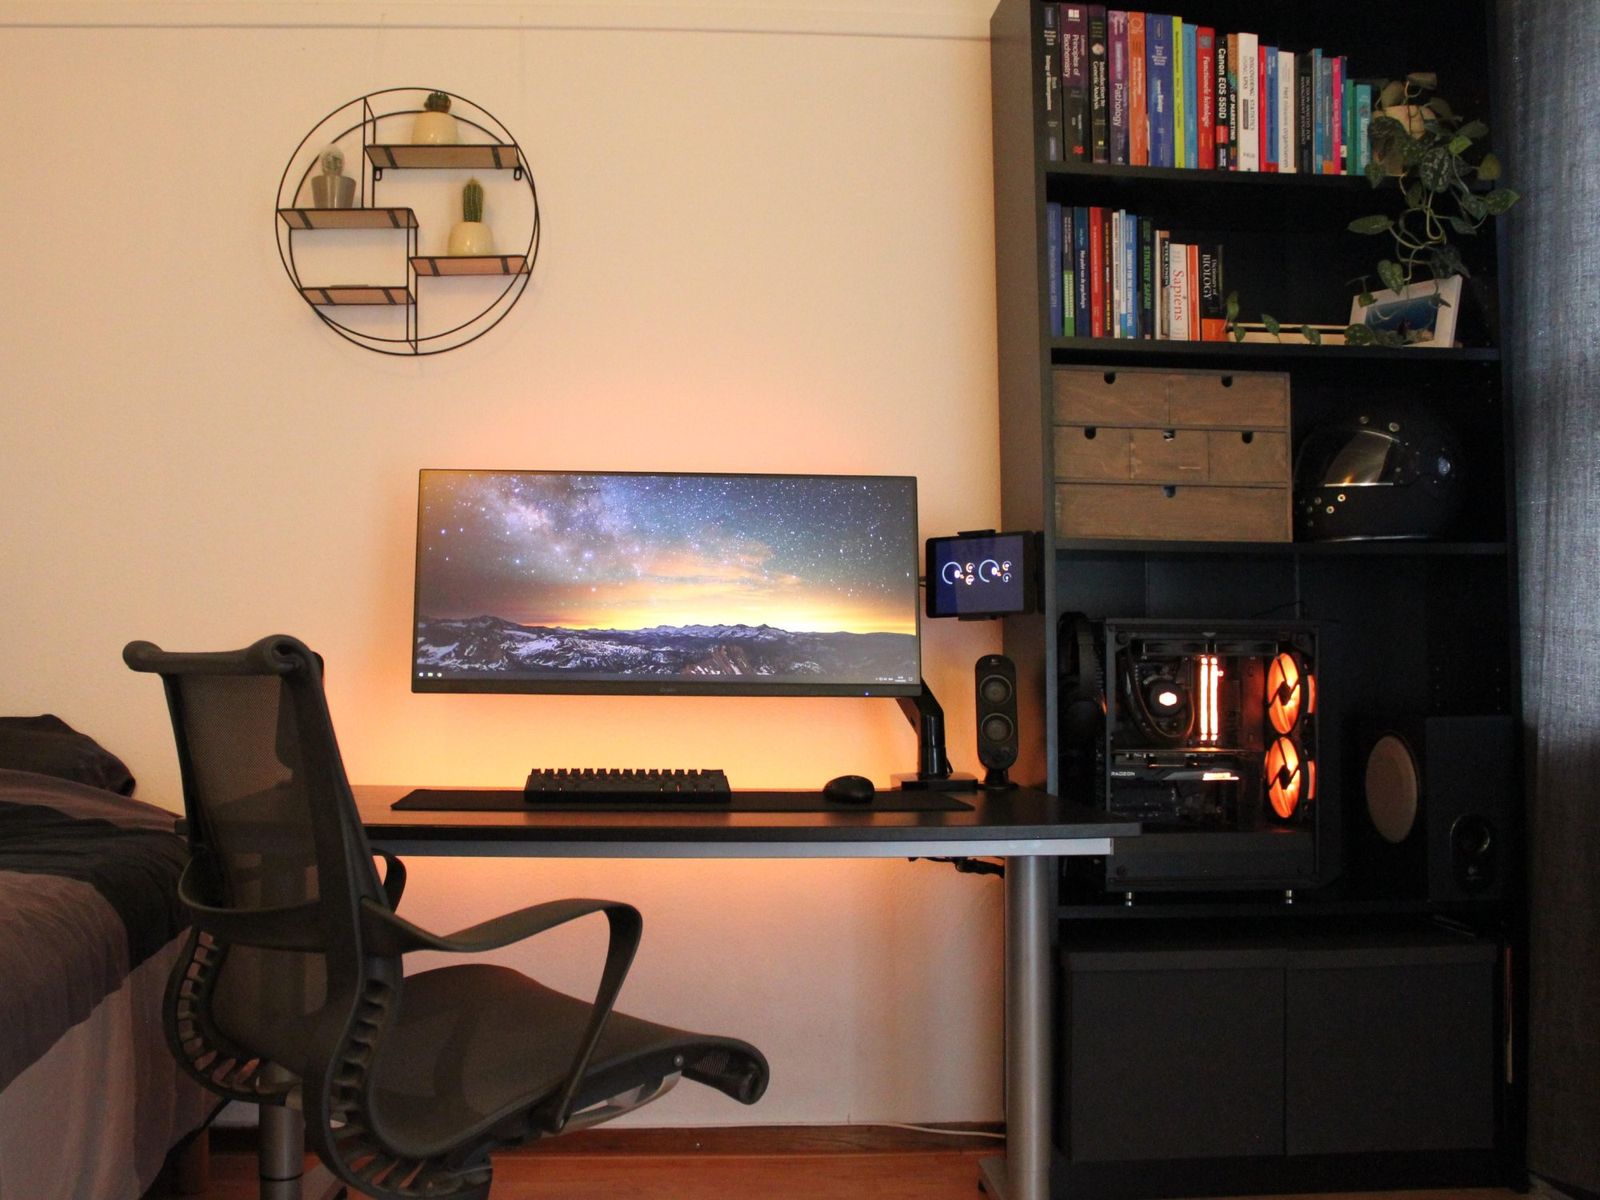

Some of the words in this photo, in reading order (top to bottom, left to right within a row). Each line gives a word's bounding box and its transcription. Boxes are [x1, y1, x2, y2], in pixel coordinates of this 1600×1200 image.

[1063, 34, 1073, 78] Biochemistry
[1072, 34, 1082, 67] Principles
[1218, 48, 1227, 75] Canon
[1073, 68, 1082, 77] of
[1218, 77, 1227, 95] EOS
[1113, 83, 1125, 126] Pathology
[1218, 97, 1227, 119] 550D
[1230, 94, 1236, 103] OF
[1202, 254, 1212, 301] BIOLOGY
[1210, 259, 1218, 288] Dictionary
[1170, 270, 1186, 321] Sapiens
